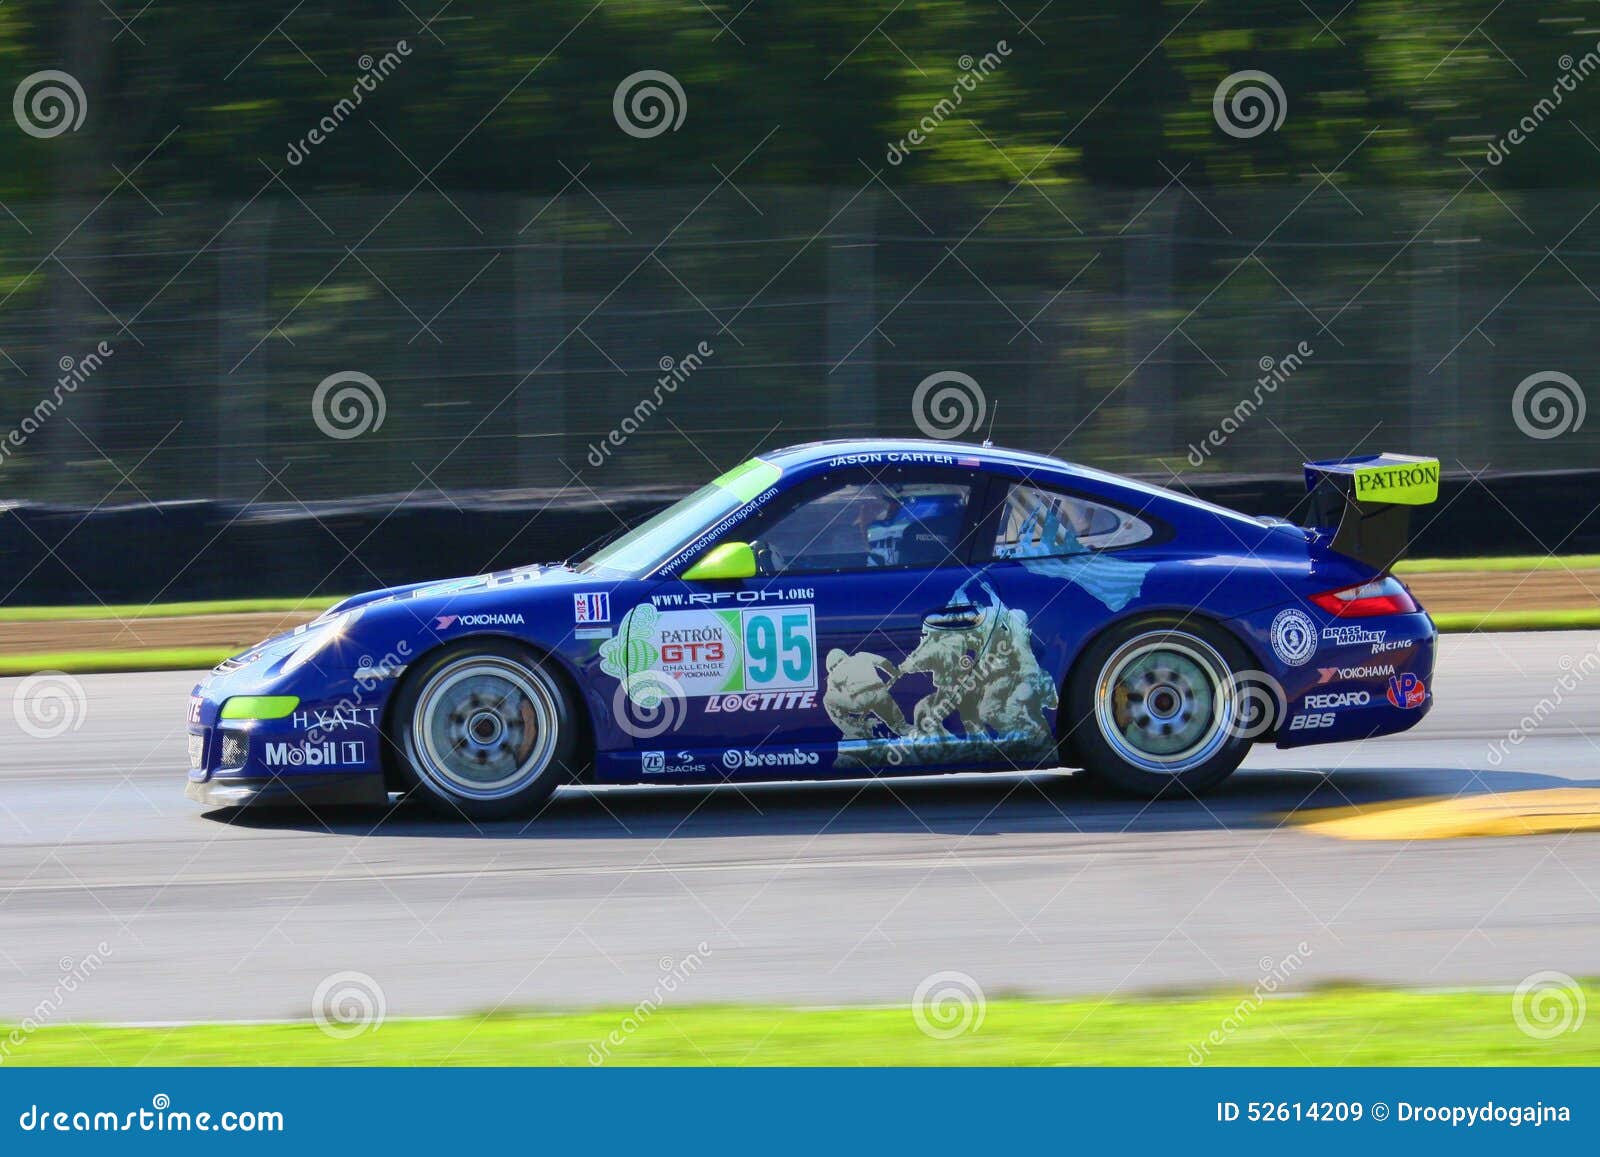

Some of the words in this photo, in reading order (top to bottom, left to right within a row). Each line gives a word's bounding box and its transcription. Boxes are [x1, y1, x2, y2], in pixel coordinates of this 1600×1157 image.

[830, 453, 882, 467] JASON
[888, 452, 954, 465] CARTER
[1359, 464, 1437, 491] PATRÓN
[659, 486, 779, 577] www.porschemotorsport.com
[458, 614, 525, 626] YOKOHAMA
[661, 625, 722, 643] PATRÓN
[1323, 626, 1361, 639] BRASS
[1337, 630, 1386, 645] MONKEY
[661, 642, 725, 663] GT3
[746, 614, 811, 683] 95
[1371, 639, 1413, 654] RACING
[662, 662, 725, 672] CHALLENGE
[1338, 665, 1395, 680] YOKOHAMA
[704, 691, 818, 713] LOCTITE
[1305, 691, 1370, 709] RECARO
[293, 708, 379, 731] HYATT
[1289, 712, 1336, 731] BBS
[265, 742, 336, 766] Mobil
[744, 749, 820, 767] brembo
[666, 765, 706, 773] SACHS
